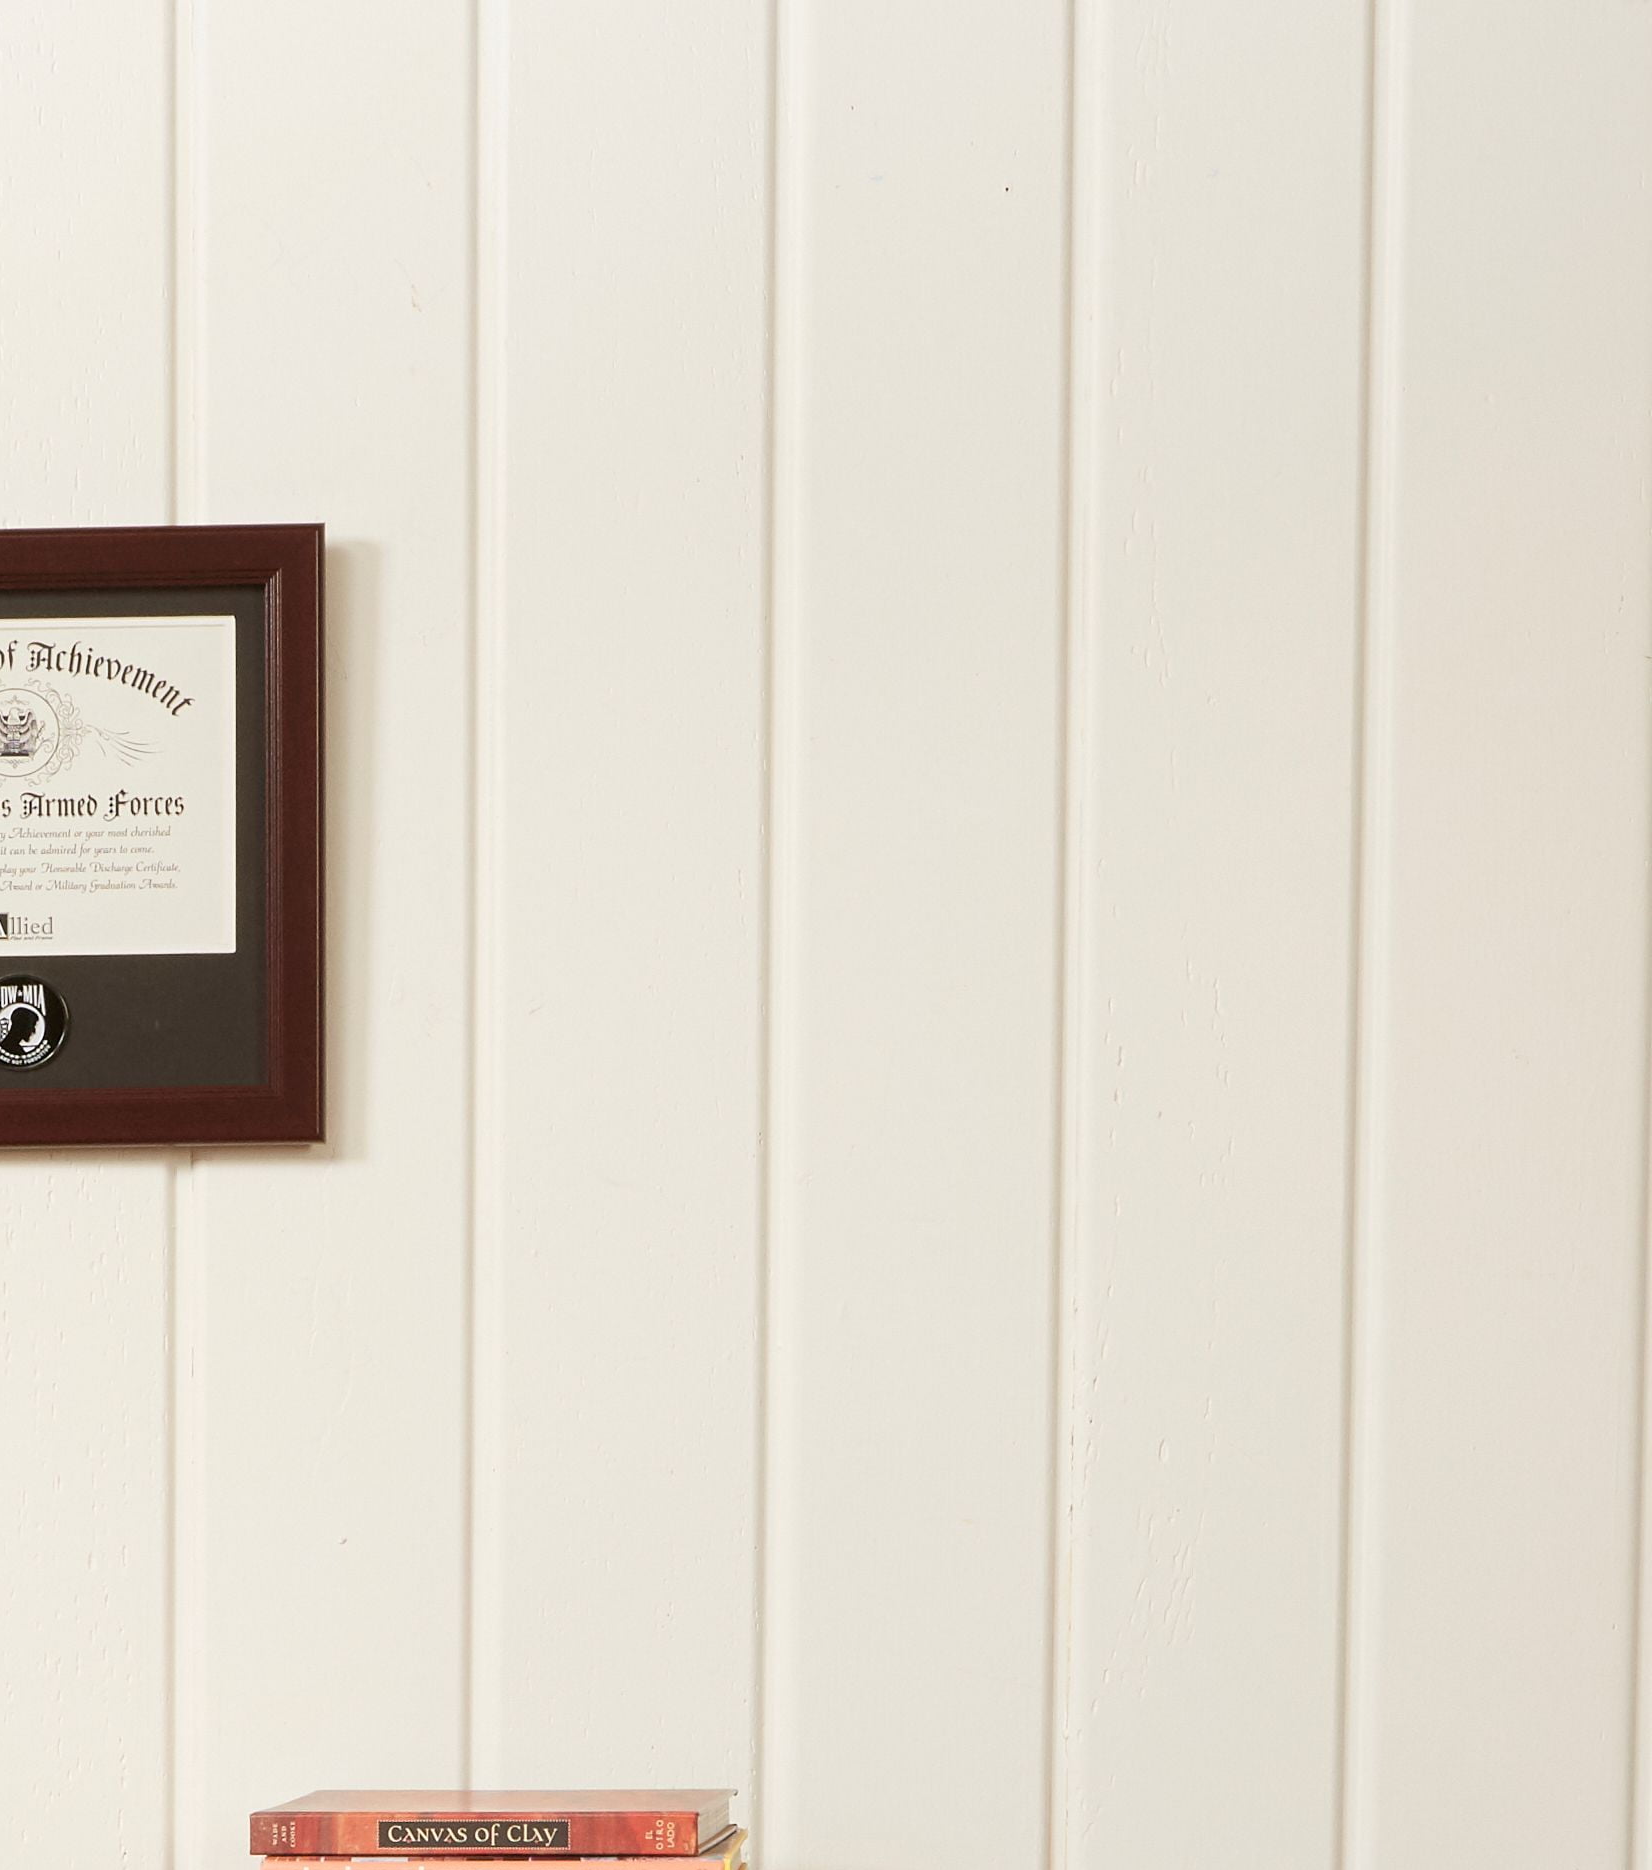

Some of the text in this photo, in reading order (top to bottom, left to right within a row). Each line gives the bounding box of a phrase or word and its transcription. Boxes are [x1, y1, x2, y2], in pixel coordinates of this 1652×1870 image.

[26, 641, 195, 717] Achievement
[19, 792, 98, 819] Armed
[103, 789, 185, 822] Forces
[8, 827, 71, 840] Achievement
[74, 830, 83, 838] or
[85, 831, 104, 841] your
[108, 829, 128, 838] most
[131, 825, 171, 838] cherished
[0, 845, 7, 856] it
[10, 848, 25, 856] can
[29, 844, 38, 855] be
[40, 843, 77, 855] admired
[78, 843, 91, 858] for
[93, 846, 117, 858] years
[120, 845, 128, 854] to
[19, 866, 37, 877] your
[41, 862, 87, 874] Honorable
[89, 861, 133, 876] Discharge
[0, 880, 33, 892] Award
[45, 879, 87, 892] Military
[89, 879, 136, 893] Graduation
[645, 1830, 653, 1840] EL
[667, 1822, 675, 1848] LADO
